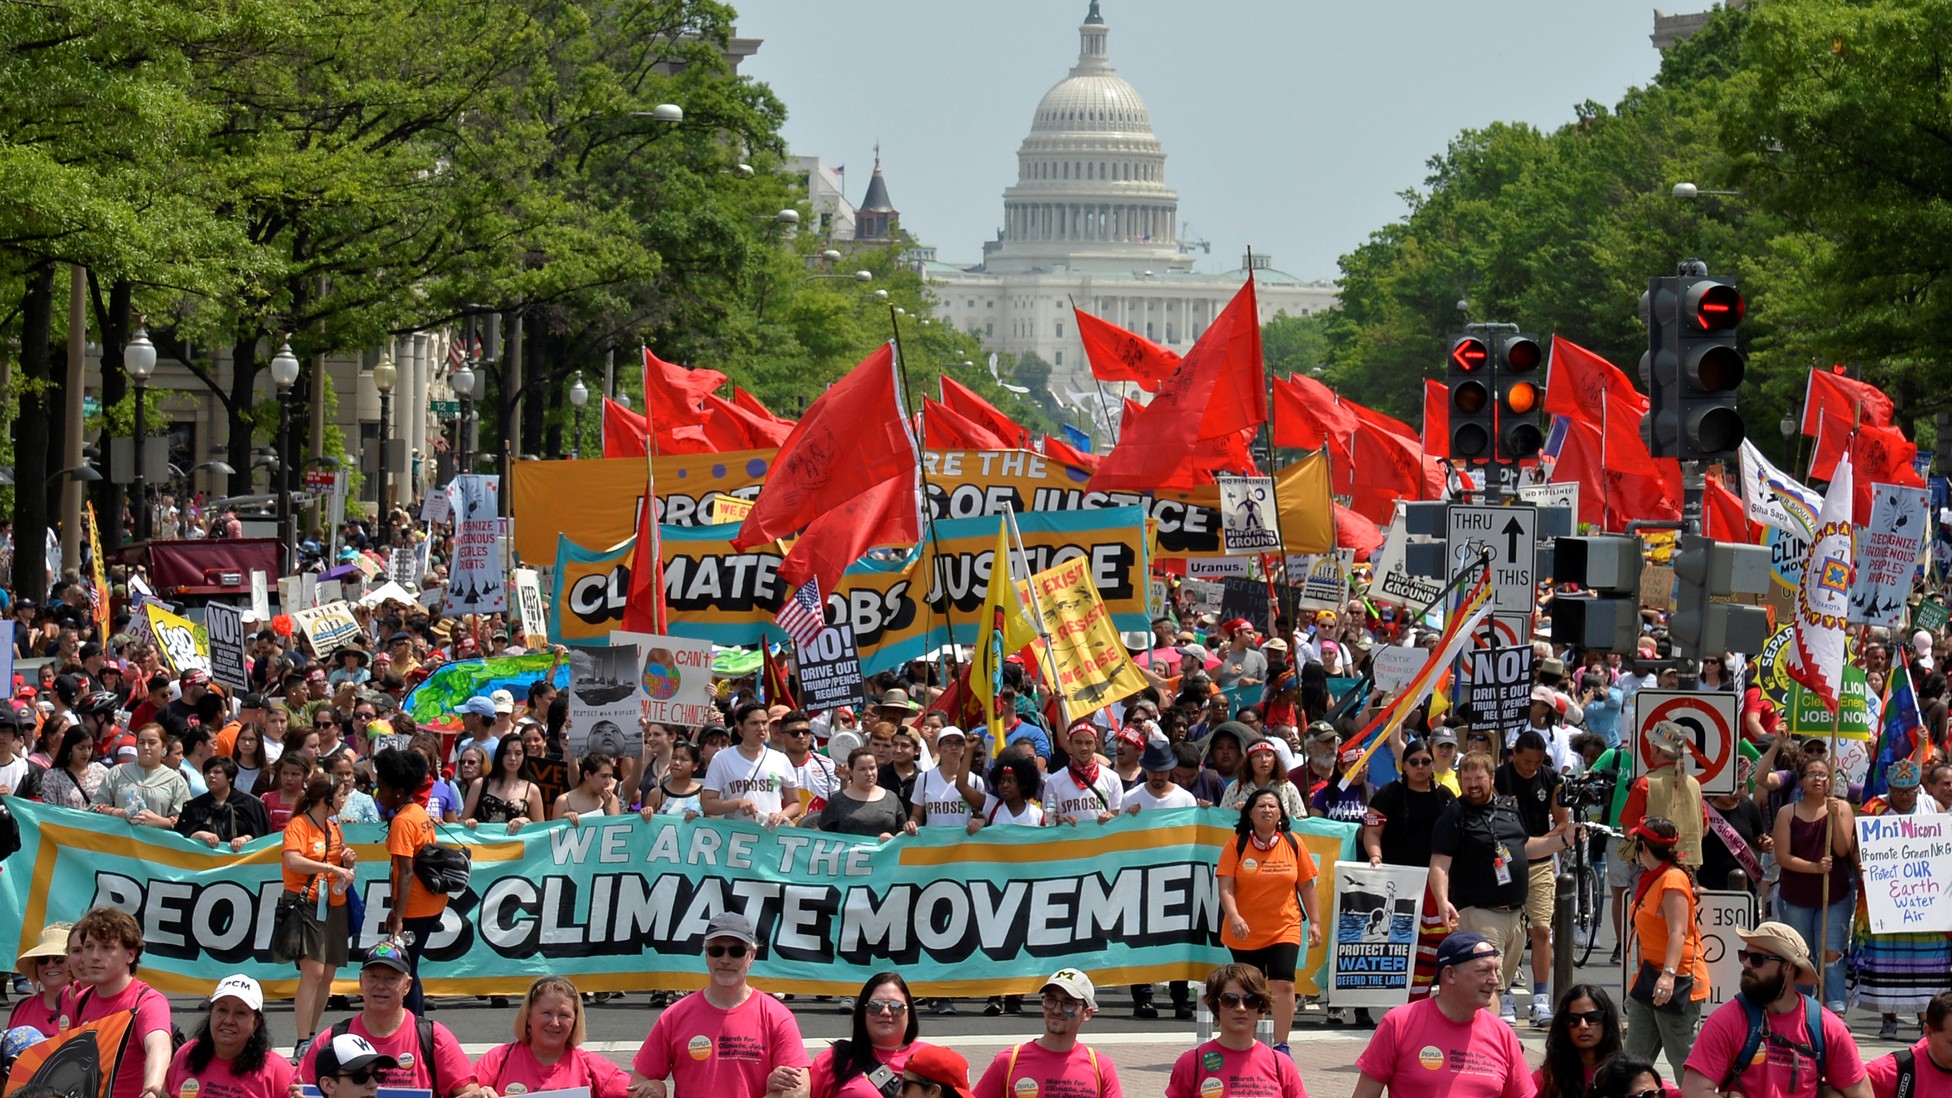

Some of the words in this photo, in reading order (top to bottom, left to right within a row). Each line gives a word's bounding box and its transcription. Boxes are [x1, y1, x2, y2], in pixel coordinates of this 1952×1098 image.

[436, 402, 446, 410] 12
[919, 451, 965, 476] RE
[978, 451, 1048, 479] THE
[1538, 488, 1574, 497] PIPELINES!
[1751, 503, 1768, 515] Siha
[1770, 508, 1788, 522] Sapa
[1790, 502, 1811, 521] SIOUX
[1454, 514, 1493, 530] THRU
[1228, 536, 1276, 548] GROUND
[1771, 538, 1806, 564] CLIM
[1190, 562, 1244, 573] Uranus.
[569, 554, 783, 615] CLMATE
[1042, 564, 1084, 596] EXIST
[1497, 570, 1528, 586] THIS
[1385, 582, 1436, 604] GROUND
[827, 580, 911, 635] OBS
[208, 606, 240, 646] NO!
[1058, 604, 1106, 640] RESIST
[796, 625, 854, 665] NO!
[1762, 627, 1794, 667] SEPAR
[801, 665, 834, 681] DRIVE
[835, 660, 858, 676] OUT
[1060, 665, 1084, 685] WE
[1084, 646, 1120, 673] RISE
[1474, 648, 1530, 685] NO!
[802, 673, 861, 692] TRUMP/PENCE
[1510, 684, 1530, 698] OUT
[814, 686, 850, 700] REGIME!
[1802, 696, 1824, 707] Clea
[1472, 697, 1530, 712] TRUM/PENCE
[1483, 709, 1518, 720] REME!
[1472, 719, 1528, 730] RefuseFcism.org
[729, 778, 773, 794] UPROSE
[1862, 819, 1899, 842] Mni
[549, 824, 633, 865] WE
[647, 824, 760, 869] ARE
[777, 835, 875, 876] THE
[1861, 847, 1898, 862] Promote
[1902, 844, 1930, 860] Green
[1930, 842, 1952, 858] NRG
[1870, 864, 1898, 882] Protect
[1903, 860, 1932, 878] OUR
[1889, 879, 1940, 898] Earth
[91, 871, 464, 951] PEOES
[481, 875, 831, 952] CLIMATE
[839, 863, 1221, 952] MOVEMEN
[1713, 908, 1746, 926] USE
[1903, 909, 1925, 924] Air
[1338, 944, 1386, 956] PROTECT
[1388, 944, 1408, 956] THE
[1338, 956, 1406, 971] WATER
[224, 980, 251, 991] PCM
[1336, 976, 1366, 986] DEFEND
[1368, 976, 1384, 985] THE
[1385, 976, 1406, 985] LAND
[1450, 1056, 1480, 1065] Climate,
[1482, 1060, 1496, 1068] Jobs
[1466, 1065, 1493, 1073] Justice
